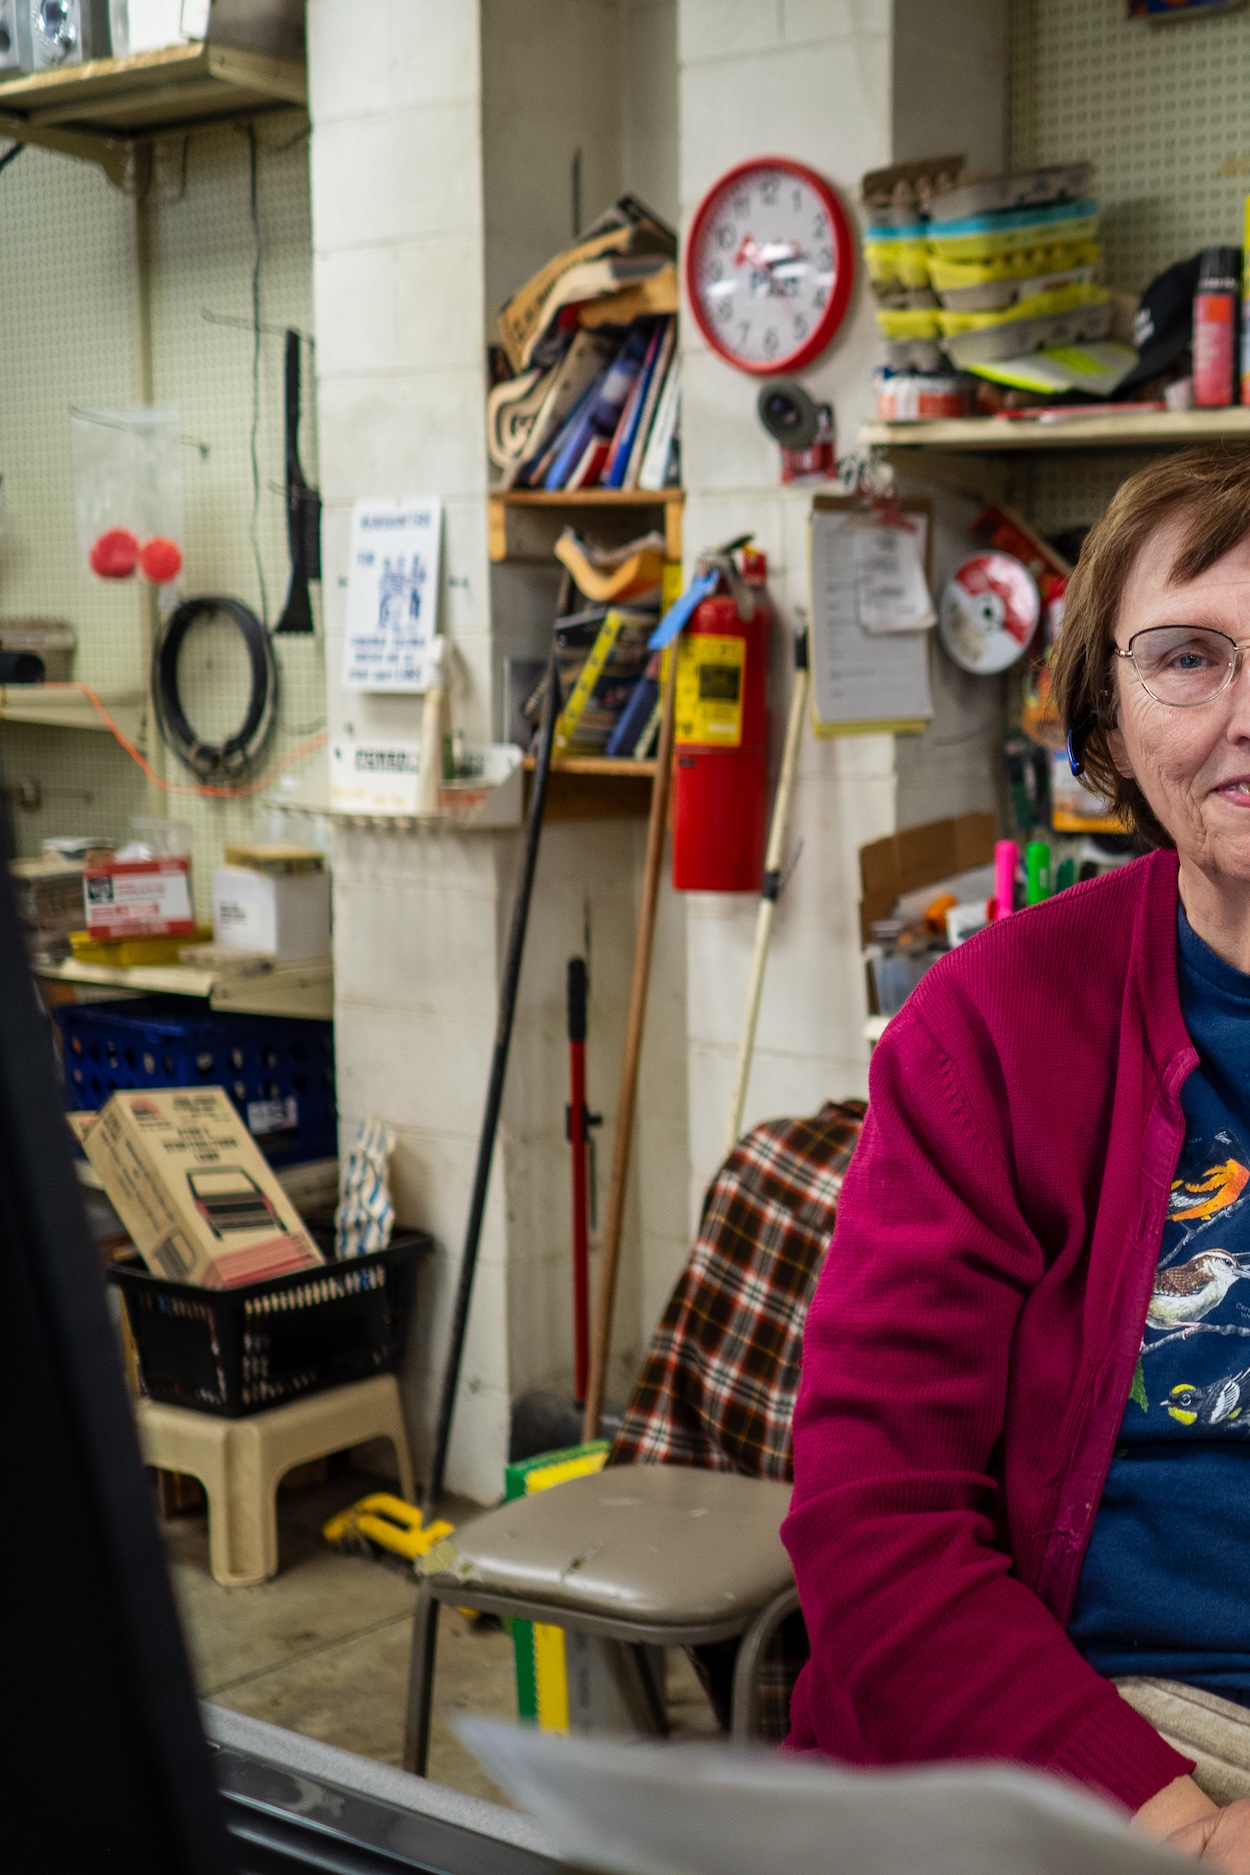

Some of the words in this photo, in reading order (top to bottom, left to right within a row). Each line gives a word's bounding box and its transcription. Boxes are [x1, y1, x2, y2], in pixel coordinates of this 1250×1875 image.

[759, 172, 781, 207] 12
[792, 190, 802, 214] 1
[734, 197, 751, 220] 11
[717, 222, 738, 250] 10
[812, 212, 826, 240] 2
[707, 257, 723, 282] 9
[818, 248, 833, 273] 3
[718, 297, 734, 322] 8
[812, 286, 826, 309] 4
[738, 319, 751, 343] 7
[792, 312, 809, 340] 5
[763, 327, 779, 352] 6
